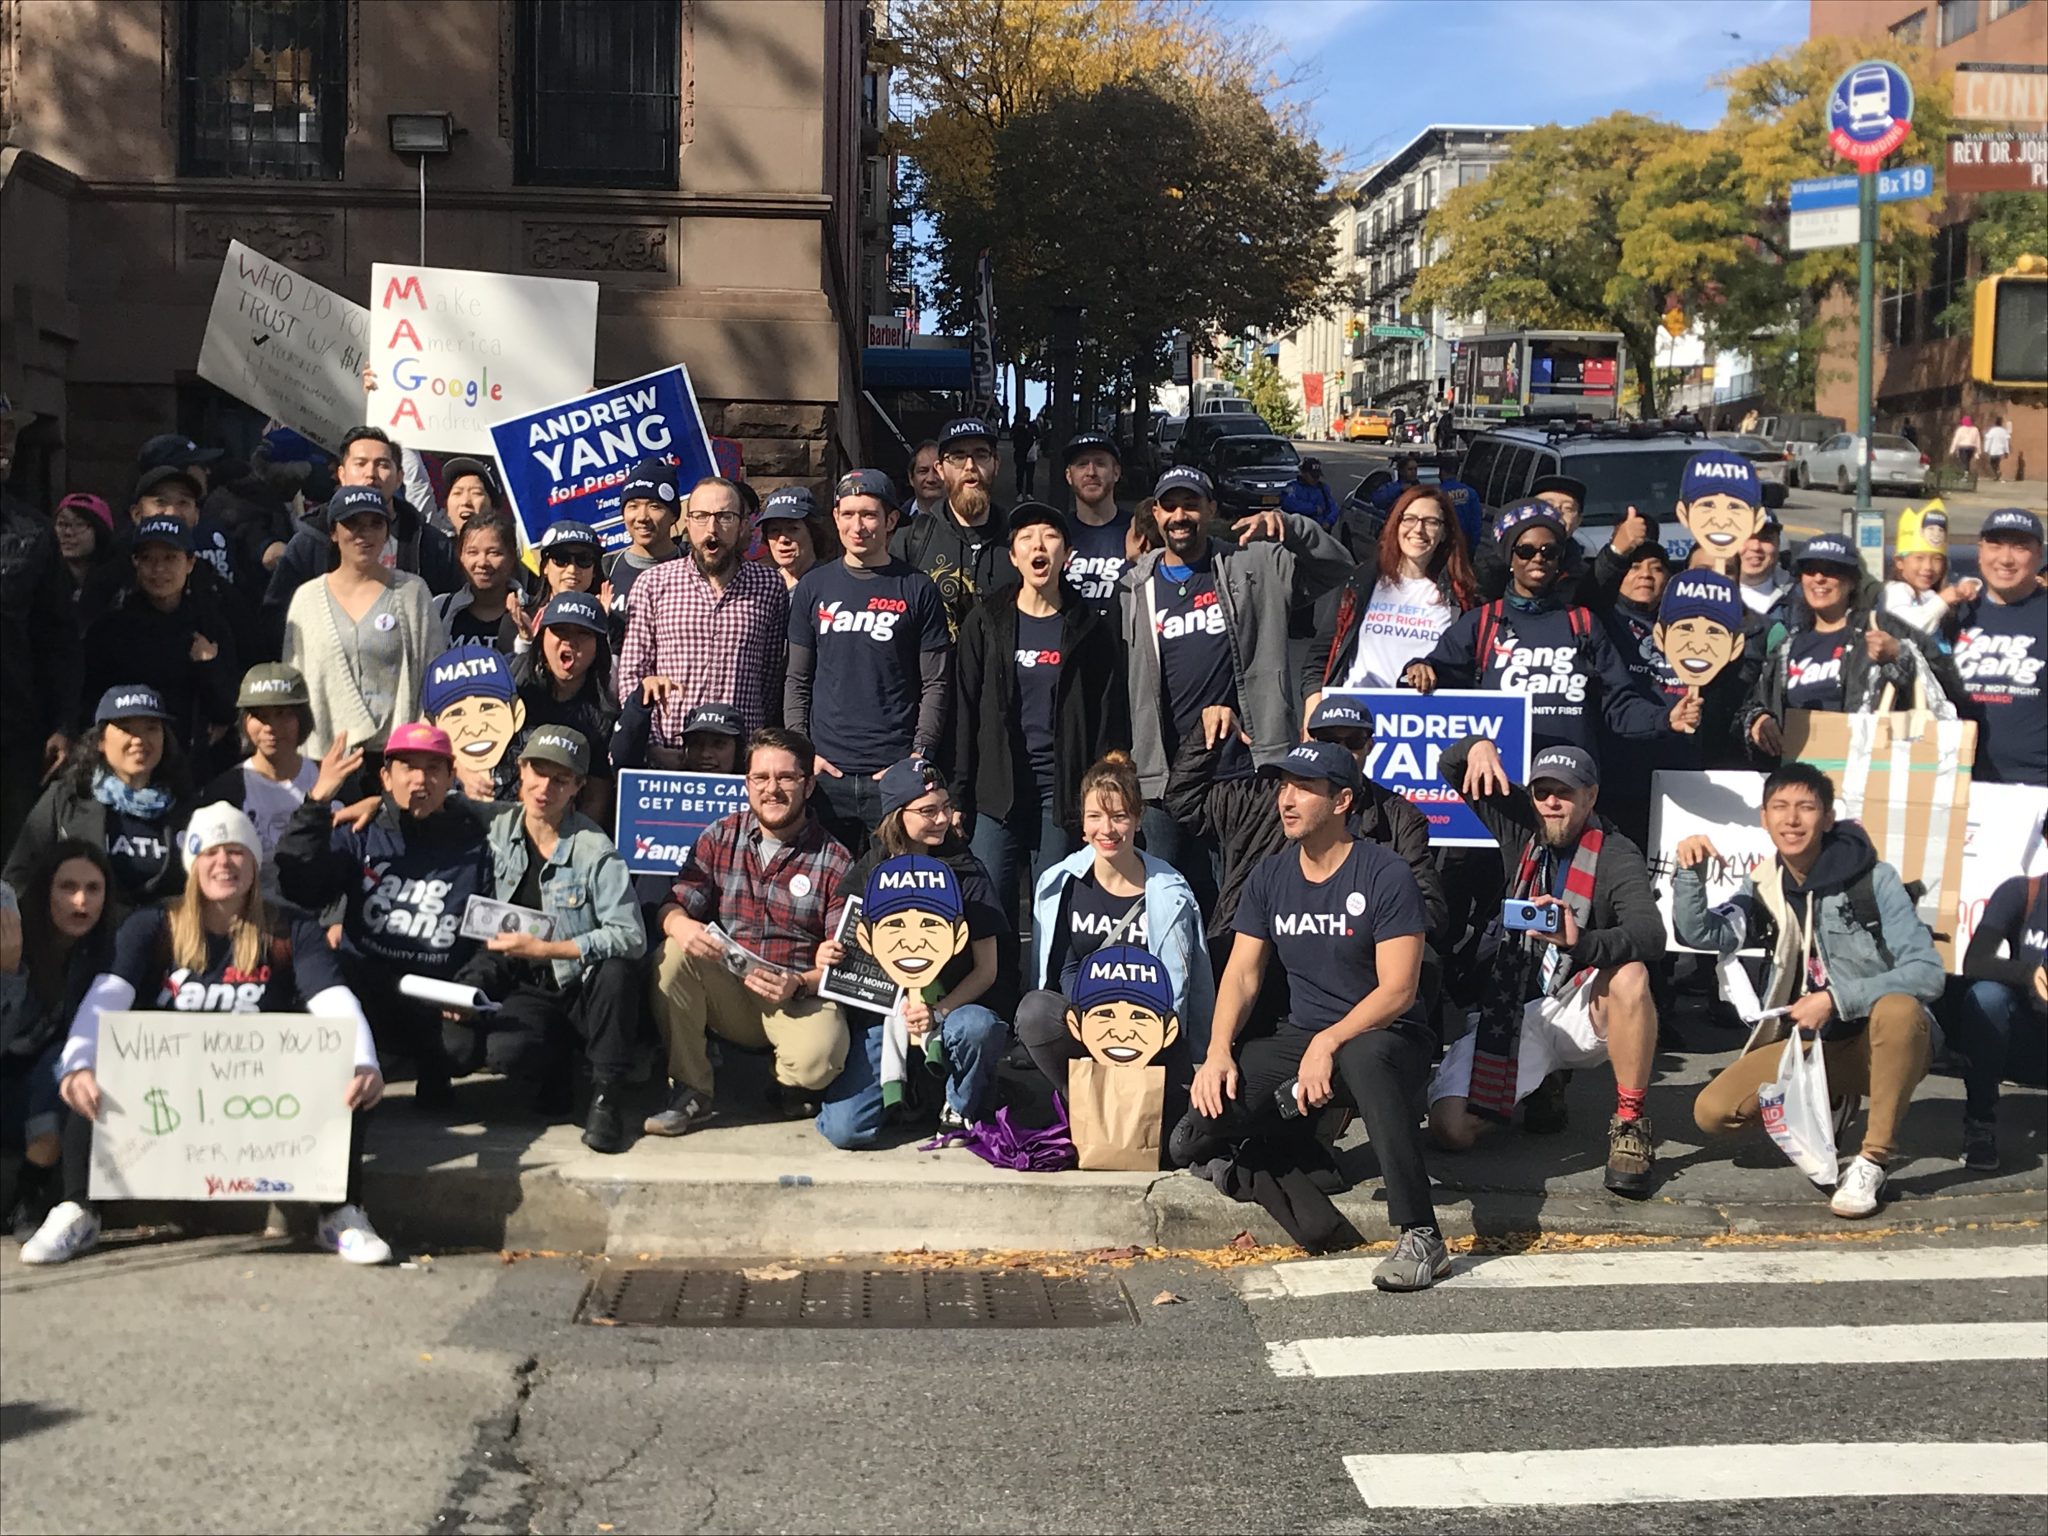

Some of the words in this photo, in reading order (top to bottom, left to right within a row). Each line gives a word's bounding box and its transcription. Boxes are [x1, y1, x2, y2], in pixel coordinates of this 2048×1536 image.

[1834, 133, 1851, 151] NO
[1850, 125, 1904, 156] STANDING
[1953, 141, 1984, 165] REV.
[1988, 141, 2013, 164] DR.
[1879, 169, 1926, 195] Bx19
[239, 253, 293, 302] WHO
[303, 286, 332, 320] DO
[383, 276, 482, 317] Make
[232, 287, 300, 338] TRUST
[388, 319, 502, 356] America
[869, 324, 902, 346] Barber
[393, 357, 503, 407] Google
[529, 386, 657, 448] ANDREW
[950, 422, 985, 435] MATH
[532, 414, 673, 482] YANG
[550, 484, 578, 503] for
[584, 452, 676, 494] Presit
[1163, 468, 1200, 481] MATH
[1694, 462, 1749, 481] MATH
[345, 492, 383, 506] MATH
[596, 495, 621, 511] Yang
[140, 520, 180, 535] MATH
[1994, 512, 2033, 528] MATH
[557, 530, 593, 542] MATH
[597, 528, 633, 548] Yang
[1809, 540, 1846, 554] MATH
[1676, 581, 1732, 603] MATH
[557, 602, 597, 620] MATH
[867, 597, 907, 612] 2020
[1370, 601, 1395, 611] NOT
[819, 600, 901, 642] Yang
[1366, 612, 1393, 623] NOT
[1953, 627, 2036, 660] Yang
[1014, 649, 1061, 669] ng20
[1493, 636, 1578, 674] Yang
[434, 656, 498, 685] MATH
[1629, 664, 1650, 674] NOT
[1787, 656, 1842, 690] Yan
[1954, 651, 2046, 685] Gang
[251, 678, 292, 694] MATH
[1500, 665, 1588, 702] Gang
[1984, 684, 2008, 693] NOT
[2008, 685, 2041, 696] RIGHT
[115, 694, 159, 710] MATH
[1530, 706, 1557, 715] ANITY
[1558, 706, 1583, 715] FIRST
[1322, 707, 1361, 720] MATH
[1372, 713, 1504, 740] NDREW
[538, 734, 579, 755] MATH
[1288, 747, 1320, 762] ATH
[1538, 754, 1577, 769] MATH
[638, 779, 707, 796] THINGS
[638, 797, 674, 811] GET
[106, 834, 169, 860] ATH
[634, 833, 692, 868] Yang
[362, 854, 453, 915] Yang
[878, 870, 947, 891] MATH
[362, 893, 462, 949] Gang
[1071, 910, 1148, 946] MATH
[1275, 912, 1354, 937] MATH.
[418, 951, 450, 965] FIRST
[863, 976, 895, 992] MONTH
[1089, 962, 1158, 984] MATH
[156, 967, 266, 1014] Yang
[111, 1022, 194, 1063] WHAT
[203, 1029, 266, 1055] WOULD
[279, 1028, 314, 1056] YOU
[317, 1026, 343, 1052] DO
[211, 1059, 265, 1081] WITH
[185, 1142, 228, 1165] PER
[239, 1135, 318, 1164] MONTH?
